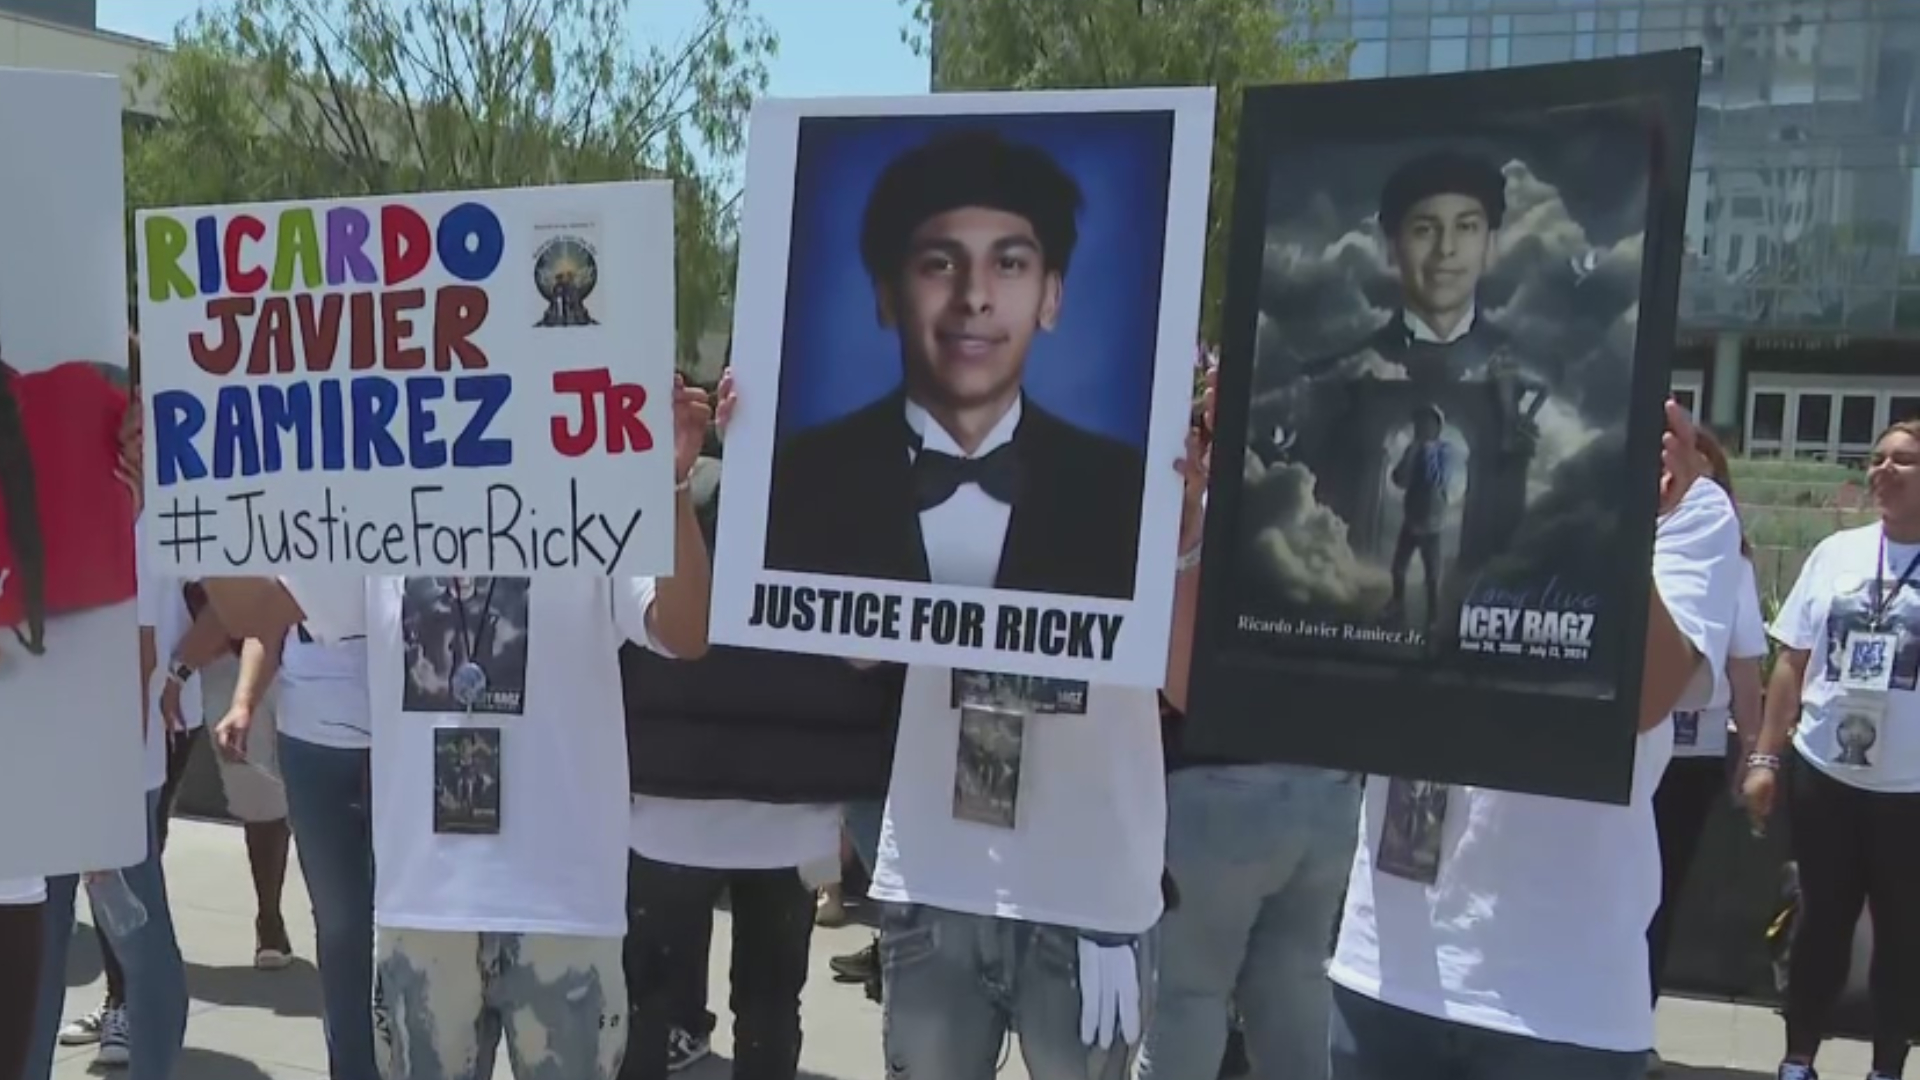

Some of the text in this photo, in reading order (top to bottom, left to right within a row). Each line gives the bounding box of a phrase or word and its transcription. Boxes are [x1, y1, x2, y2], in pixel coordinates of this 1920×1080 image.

[145, 202, 504, 301] RICARDO
[188, 285, 489, 375] JAVIER
[153, 368, 653, 485] RAMIREZ JR
[158, 477, 642, 575] #JusticeForRicky
[748, 583, 1124, 661] JUSTICE FOR RICKY
[1237, 614, 1427, 646] Ricardo Javier Ramirez Jr.
[1460, 604, 1595, 648] ICEY BAGZ
